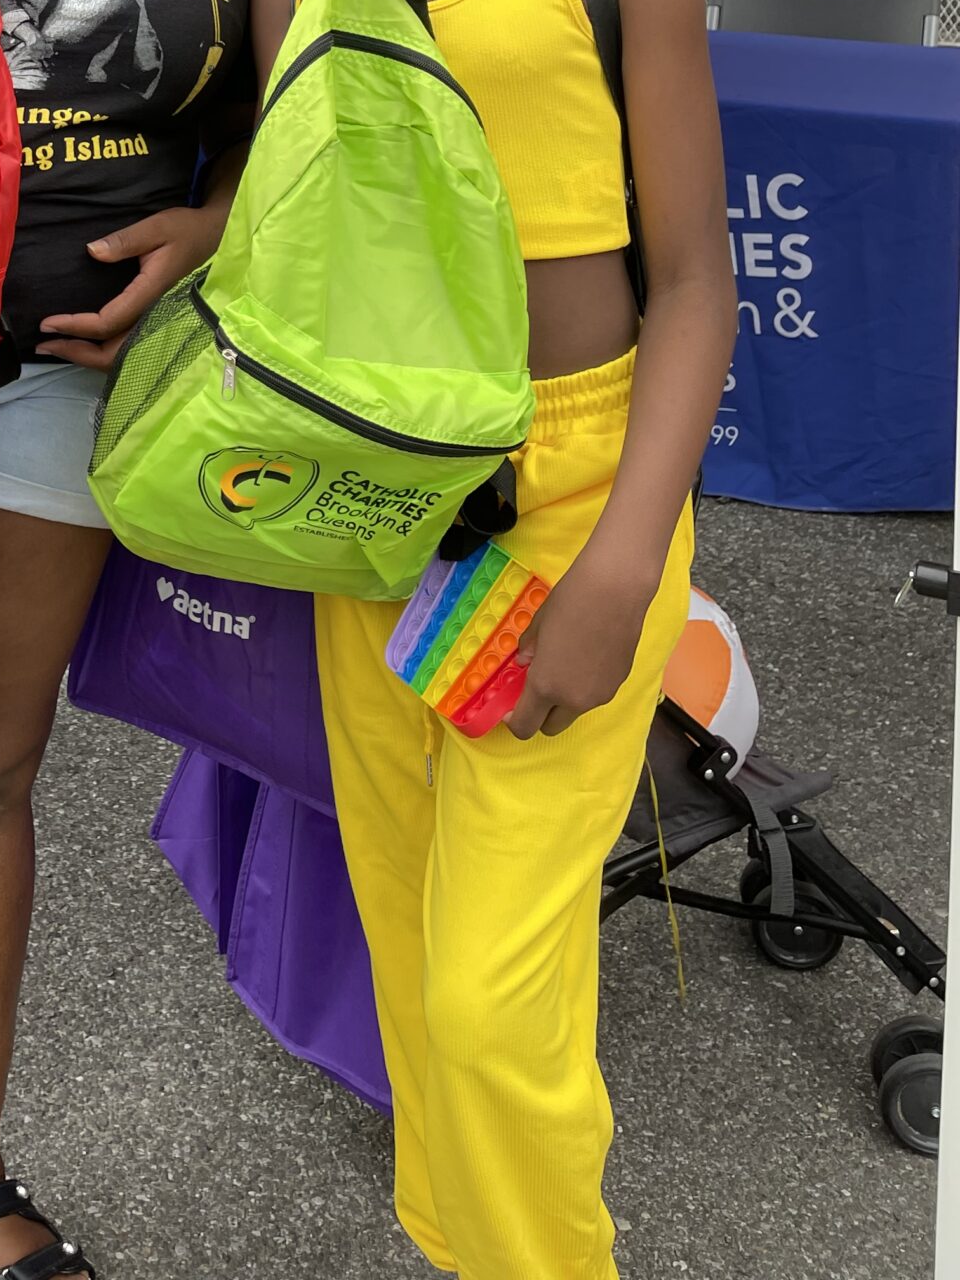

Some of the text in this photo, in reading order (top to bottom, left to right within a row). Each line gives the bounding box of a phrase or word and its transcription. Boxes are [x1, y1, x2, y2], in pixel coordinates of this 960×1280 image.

[63, 133, 149, 162] Island
[329, 480, 428, 521] CHARITIES
[341, 470, 443, 506] CATHOLIC
[306, 508, 376, 541] Queens
[315, 491, 413, 537] Brooklyn &
